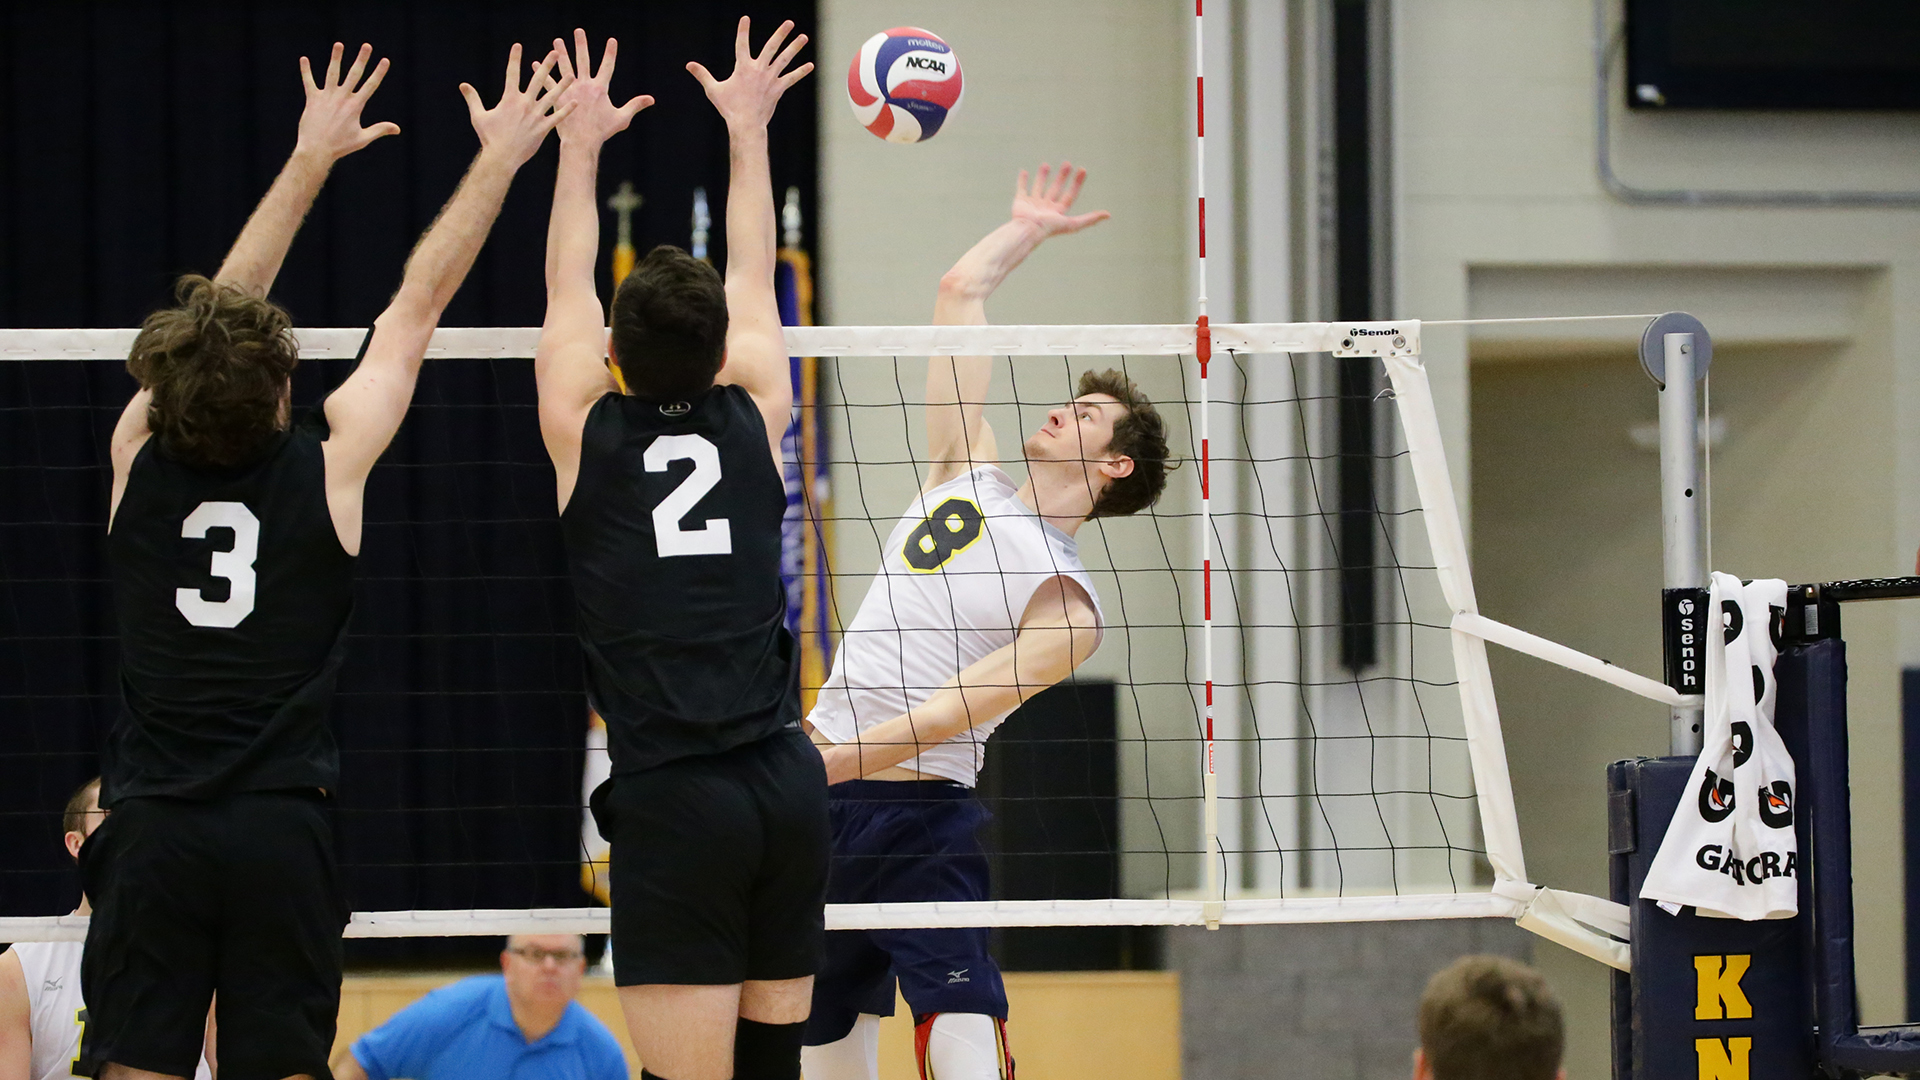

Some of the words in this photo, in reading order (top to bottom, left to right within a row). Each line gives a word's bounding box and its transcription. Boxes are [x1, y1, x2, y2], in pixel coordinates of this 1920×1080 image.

[906, 56, 946, 75] NCAA
[907, 38, 945, 53] molten
[1359, 328, 1400, 336] Senoh
[643, 433, 732, 558] 2
[175, 501, 260, 629] 3
[901, 496, 986, 574] 8
[1681, 618, 1696, 686] senoh
